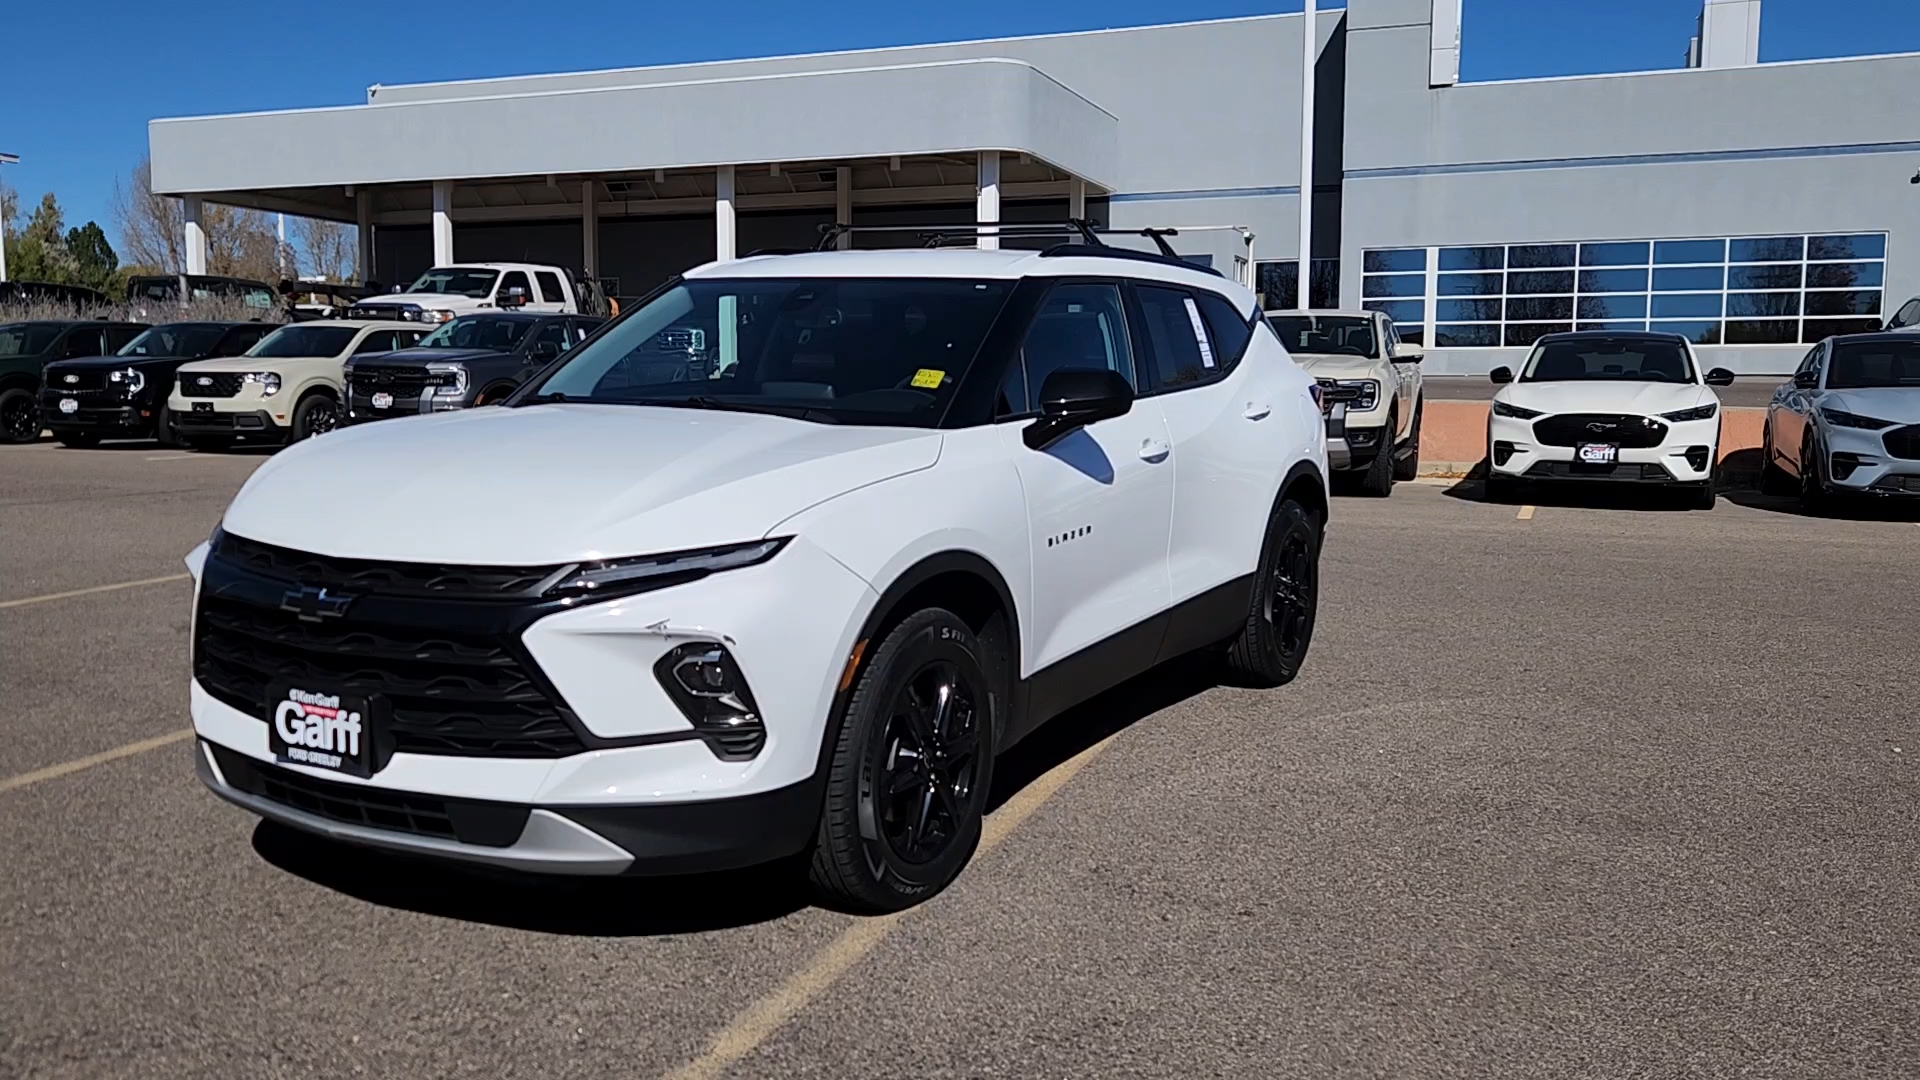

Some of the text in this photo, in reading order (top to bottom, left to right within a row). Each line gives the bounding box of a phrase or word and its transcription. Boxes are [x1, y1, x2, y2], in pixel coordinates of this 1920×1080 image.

[1579, 446, 1616, 460] Garff
[1047, 525, 1092, 547] BLAZER
[275, 700, 361, 755] Garff
